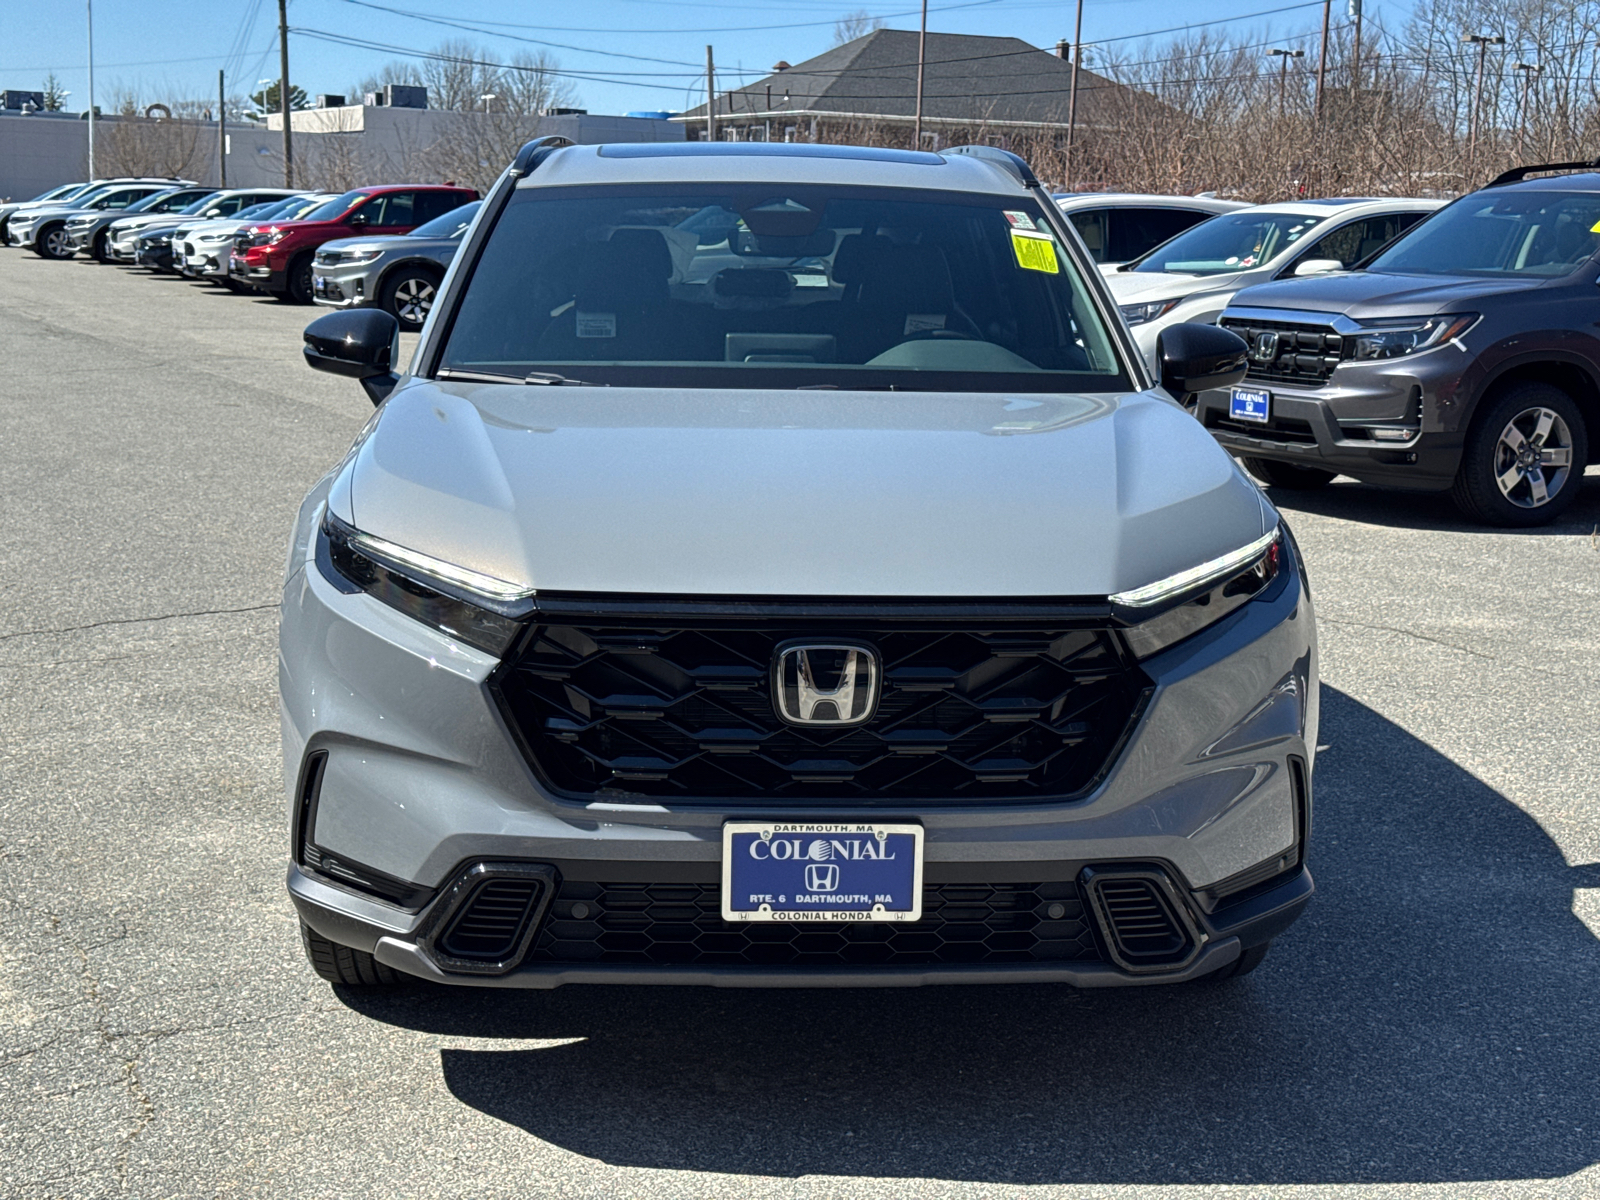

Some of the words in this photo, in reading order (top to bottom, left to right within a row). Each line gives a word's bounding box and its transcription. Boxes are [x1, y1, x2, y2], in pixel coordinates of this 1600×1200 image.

[774, 825, 852, 833] DARTMOUTH,
[856, 825, 874, 833] MA
[749, 839, 896, 861] COLONIAL
[750, 894, 776, 903] RTE.
[778, 894, 786, 903] 6
[795, 894, 872, 904] DARTMOUTH,
[874, 894, 893, 903] MA
[771, 912, 829, 921] COLONIAL
[831, 912, 872, 921] HONDA
